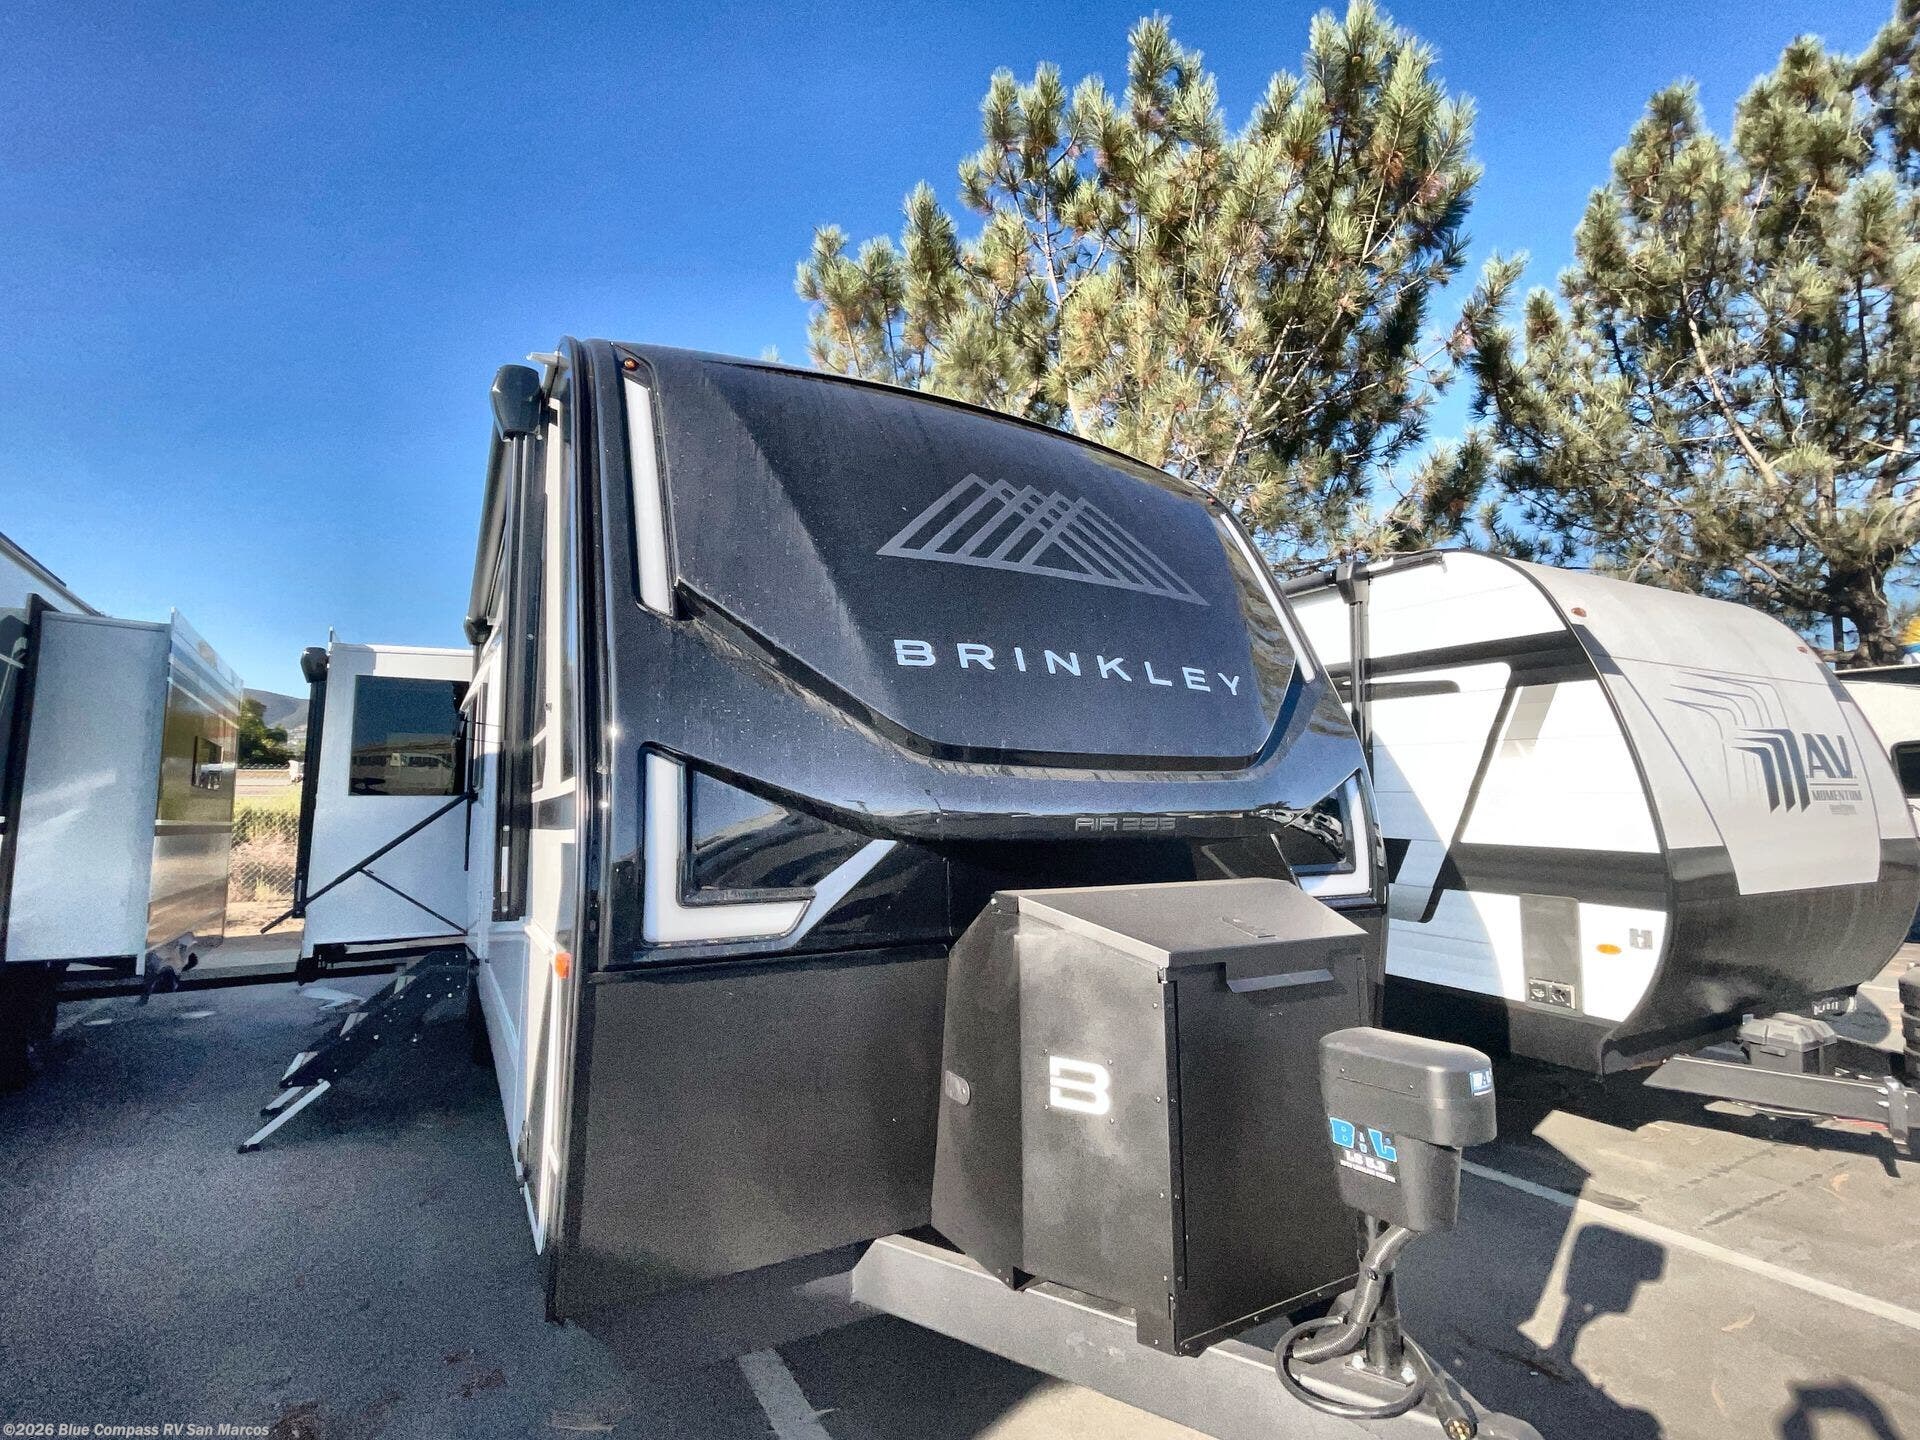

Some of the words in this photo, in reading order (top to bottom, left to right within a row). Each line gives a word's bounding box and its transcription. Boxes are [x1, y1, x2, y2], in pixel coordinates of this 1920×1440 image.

[893, 639, 1240, 696] BRINKLEY
[1811, 790, 1863, 801] MOMENTUM
[1074, 817, 1118, 831] AIR
[1049, 1055, 1111, 1115] B
